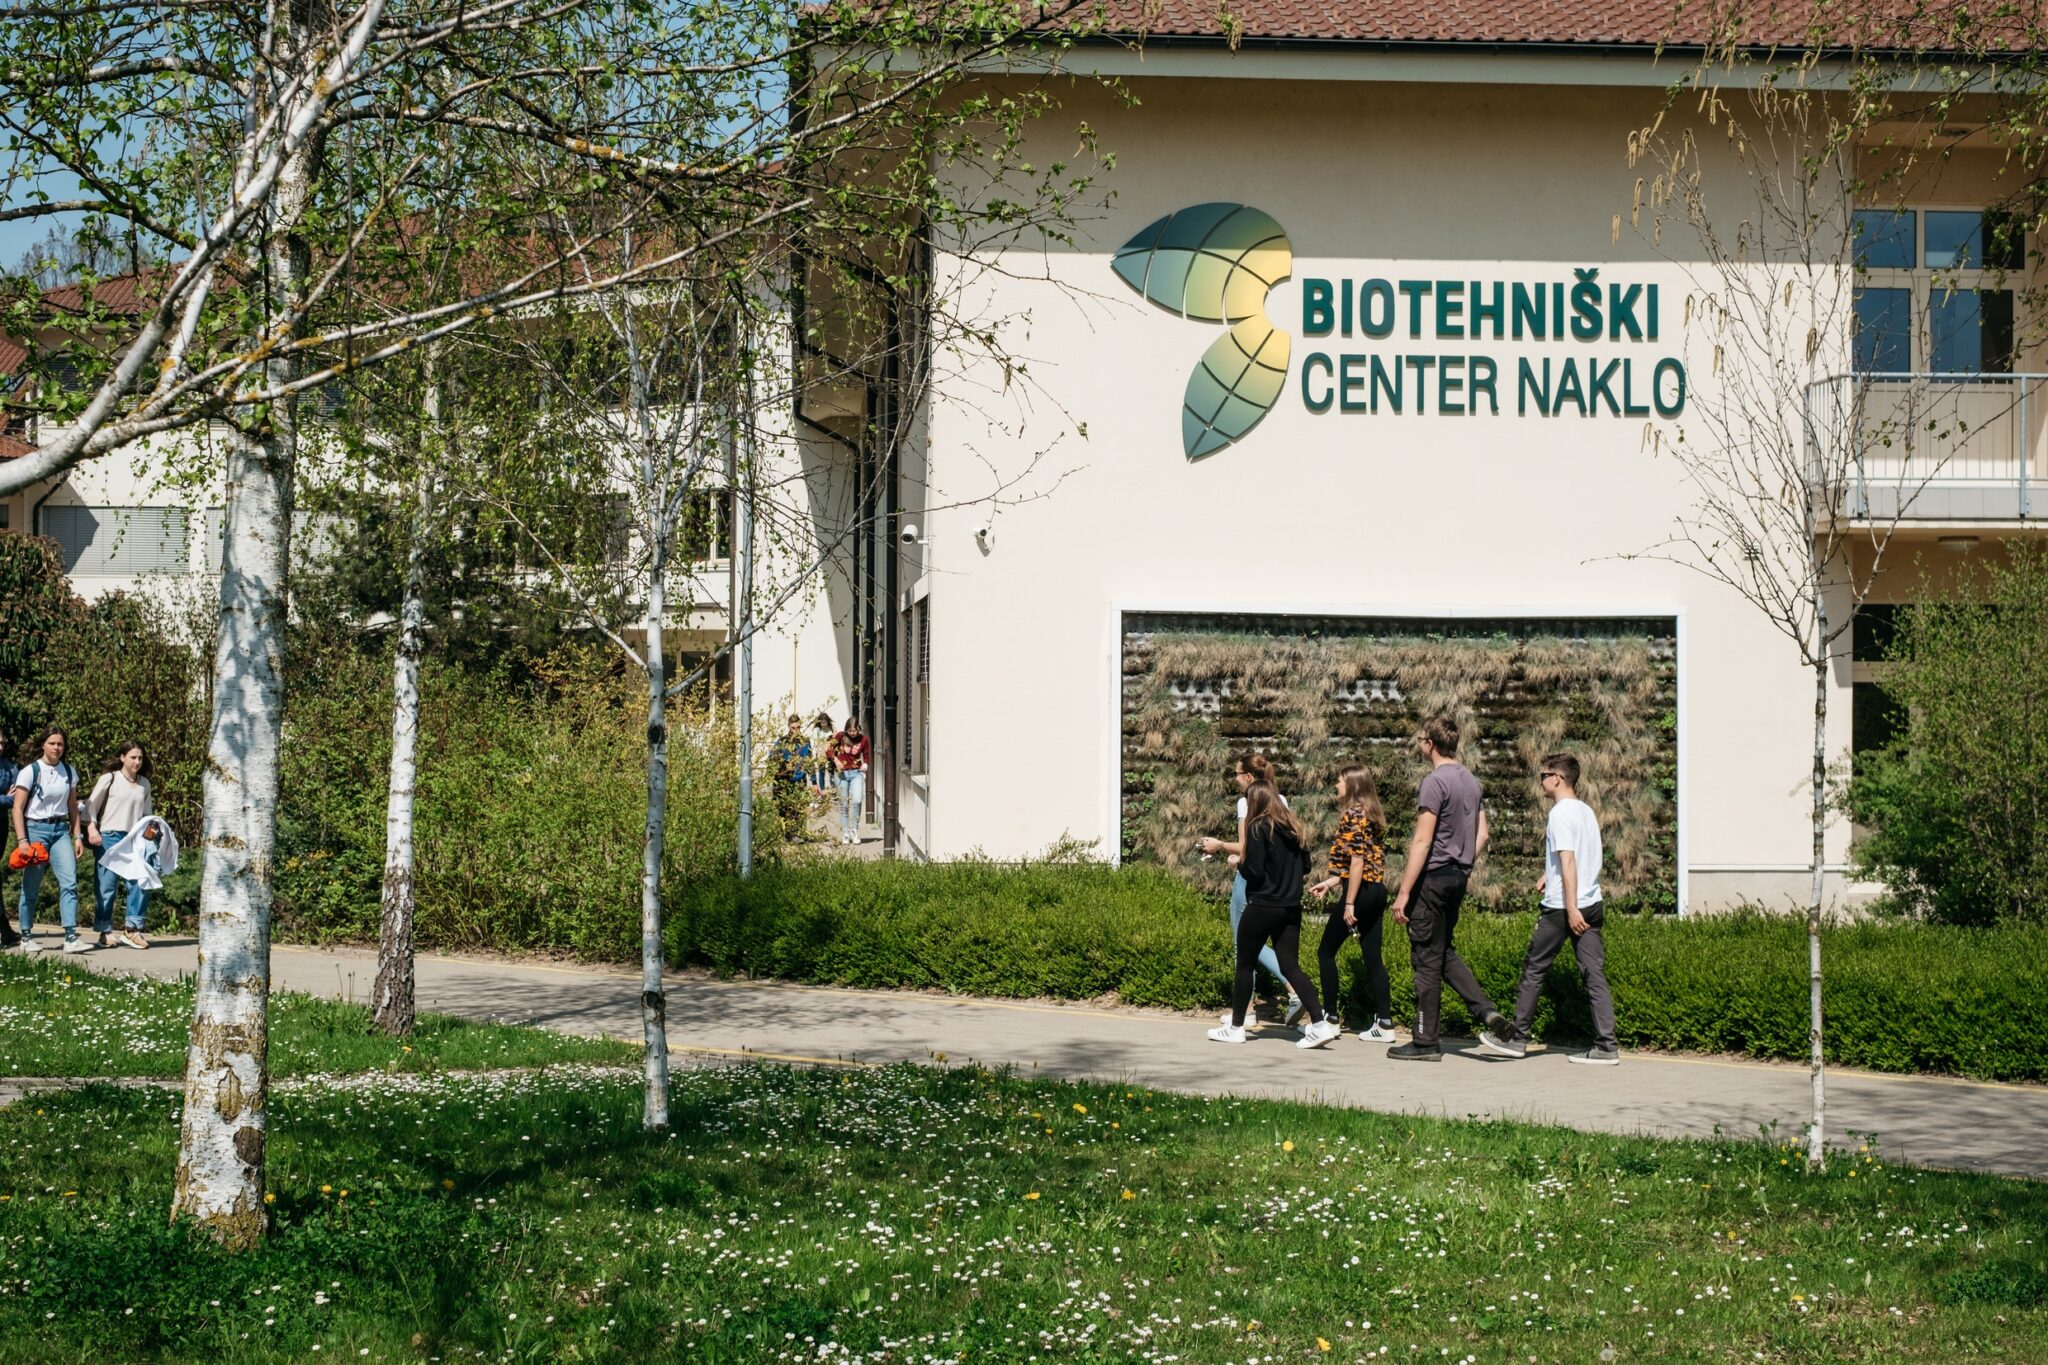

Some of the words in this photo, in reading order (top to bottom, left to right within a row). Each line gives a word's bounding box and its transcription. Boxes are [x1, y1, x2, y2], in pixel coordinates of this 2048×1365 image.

[1302, 268, 1659, 338] BIOTEHNIŠKI
[1301, 352, 1499, 414] CENTER
[1518, 357, 1687, 416] NAKLO
